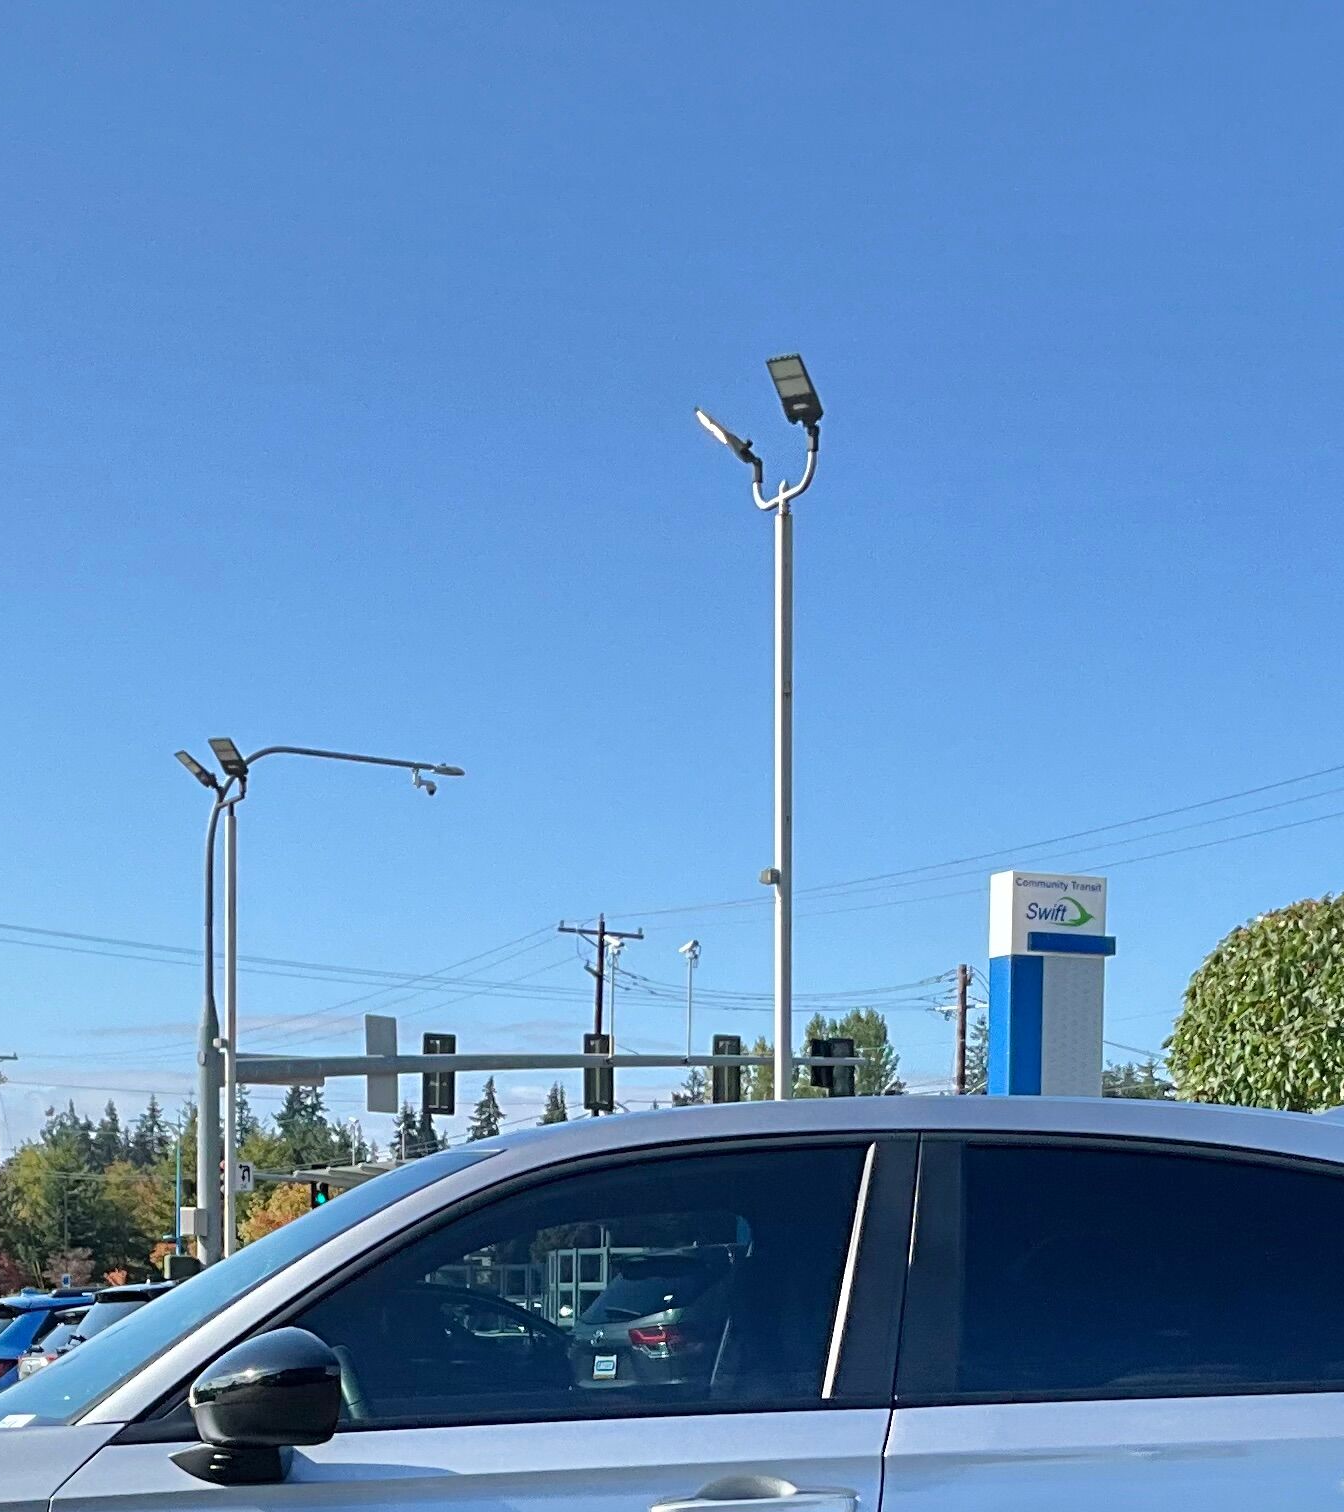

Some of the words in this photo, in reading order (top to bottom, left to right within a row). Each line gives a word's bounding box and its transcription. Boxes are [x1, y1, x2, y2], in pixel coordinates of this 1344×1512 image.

[1015, 877, 1068, 891] Community
[1071, 881, 1102, 892] Transit
[1026, 902, 1067, 921] Swift
